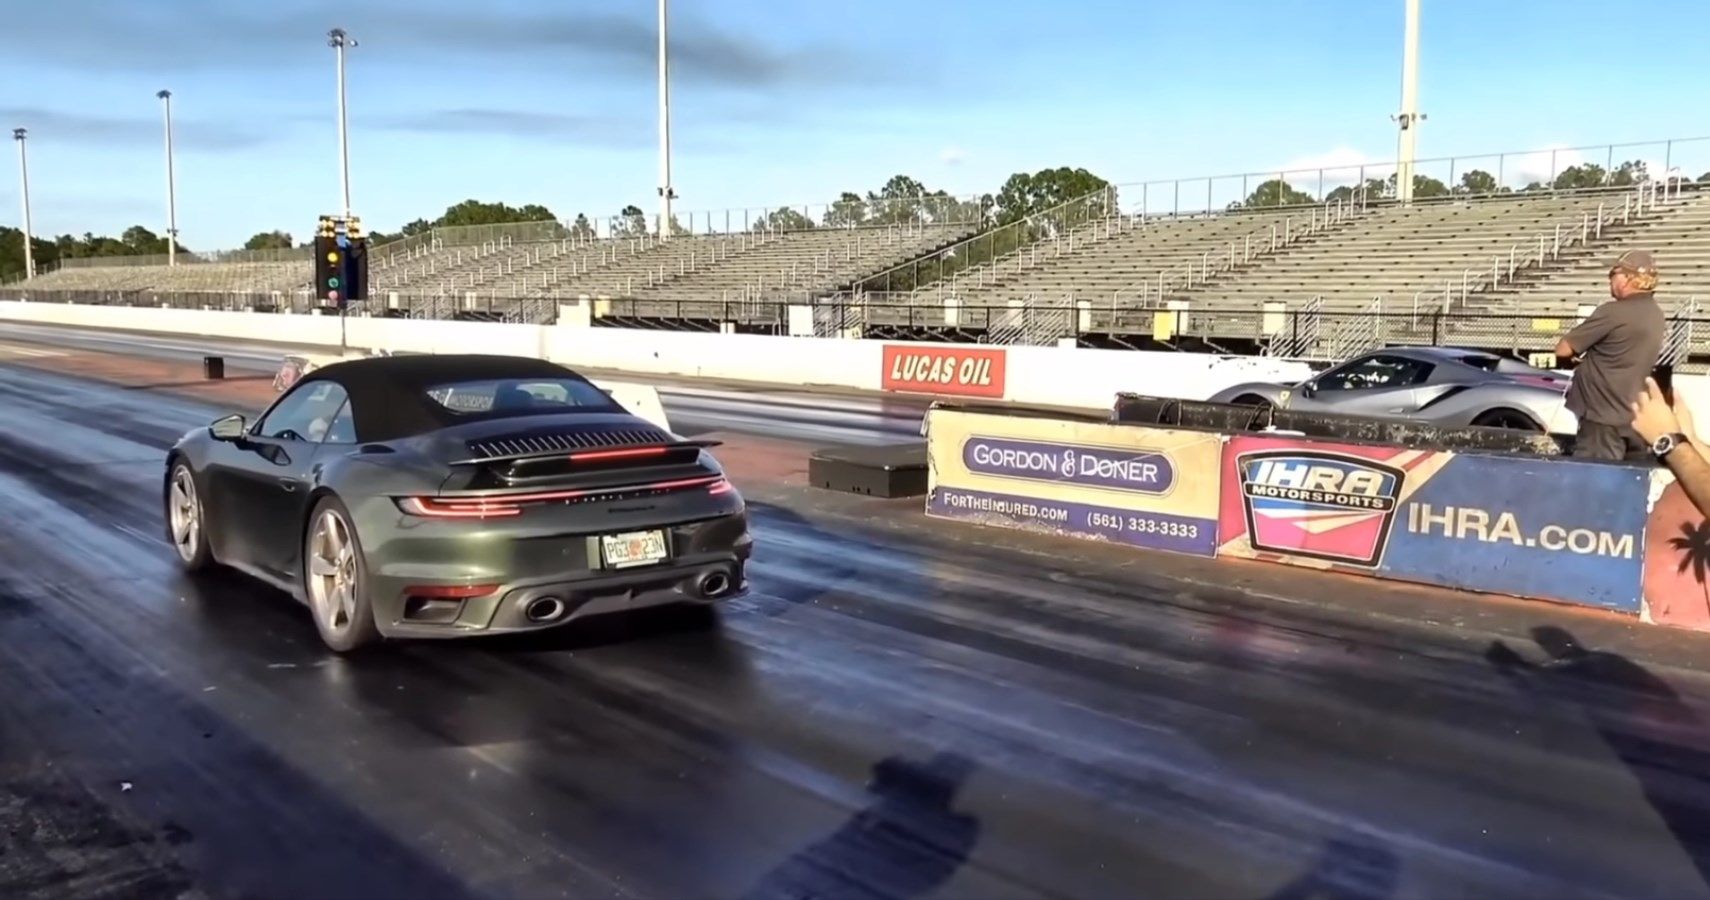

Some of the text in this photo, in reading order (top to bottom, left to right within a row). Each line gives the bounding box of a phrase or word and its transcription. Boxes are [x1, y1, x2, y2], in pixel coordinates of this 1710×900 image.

[891, 354, 991, 386] LUCAS OIL
[973, 444, 1158, 483] GORDON & DONER
[1254, 460, 1384, 497] IHRA
[1252, 484, 1385, 509] MOTORSPORTS
[1087, 511, 1123, 531] (561)
[1128, 517, 1198, 539] 333-3333
[1407, 502, 1634, 560] IHRA.COM
